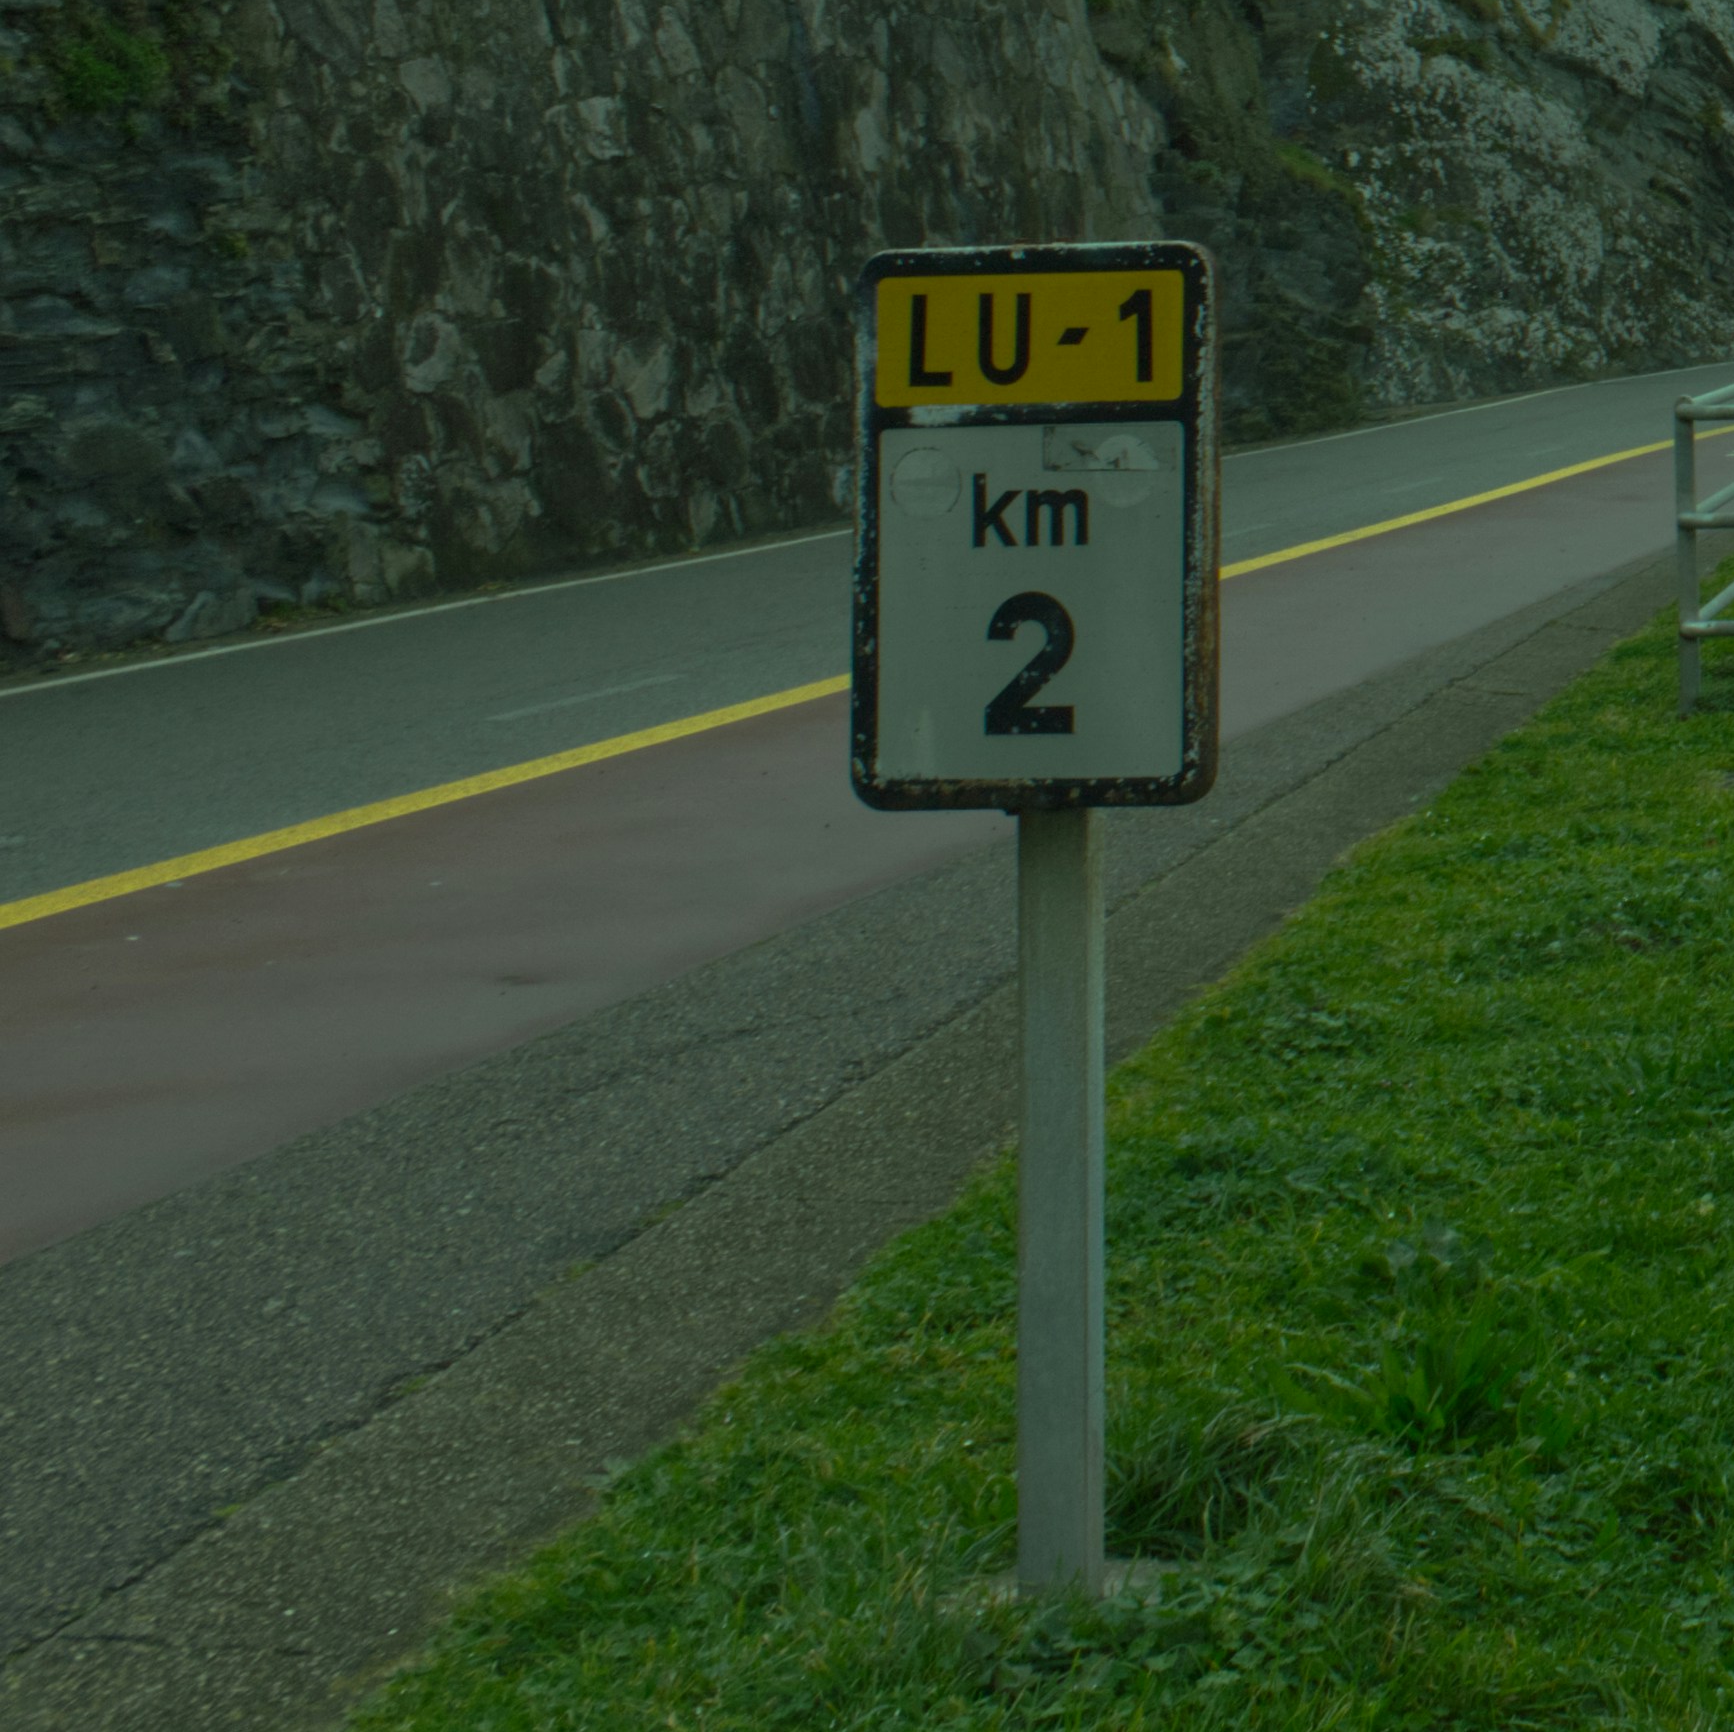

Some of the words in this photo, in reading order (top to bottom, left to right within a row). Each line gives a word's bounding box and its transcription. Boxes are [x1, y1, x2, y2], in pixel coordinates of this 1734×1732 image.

[908, 289, 1154, 387] LU-1
[972, 473, 1089, 548] km
[984, 591, 1075, 736] 2
